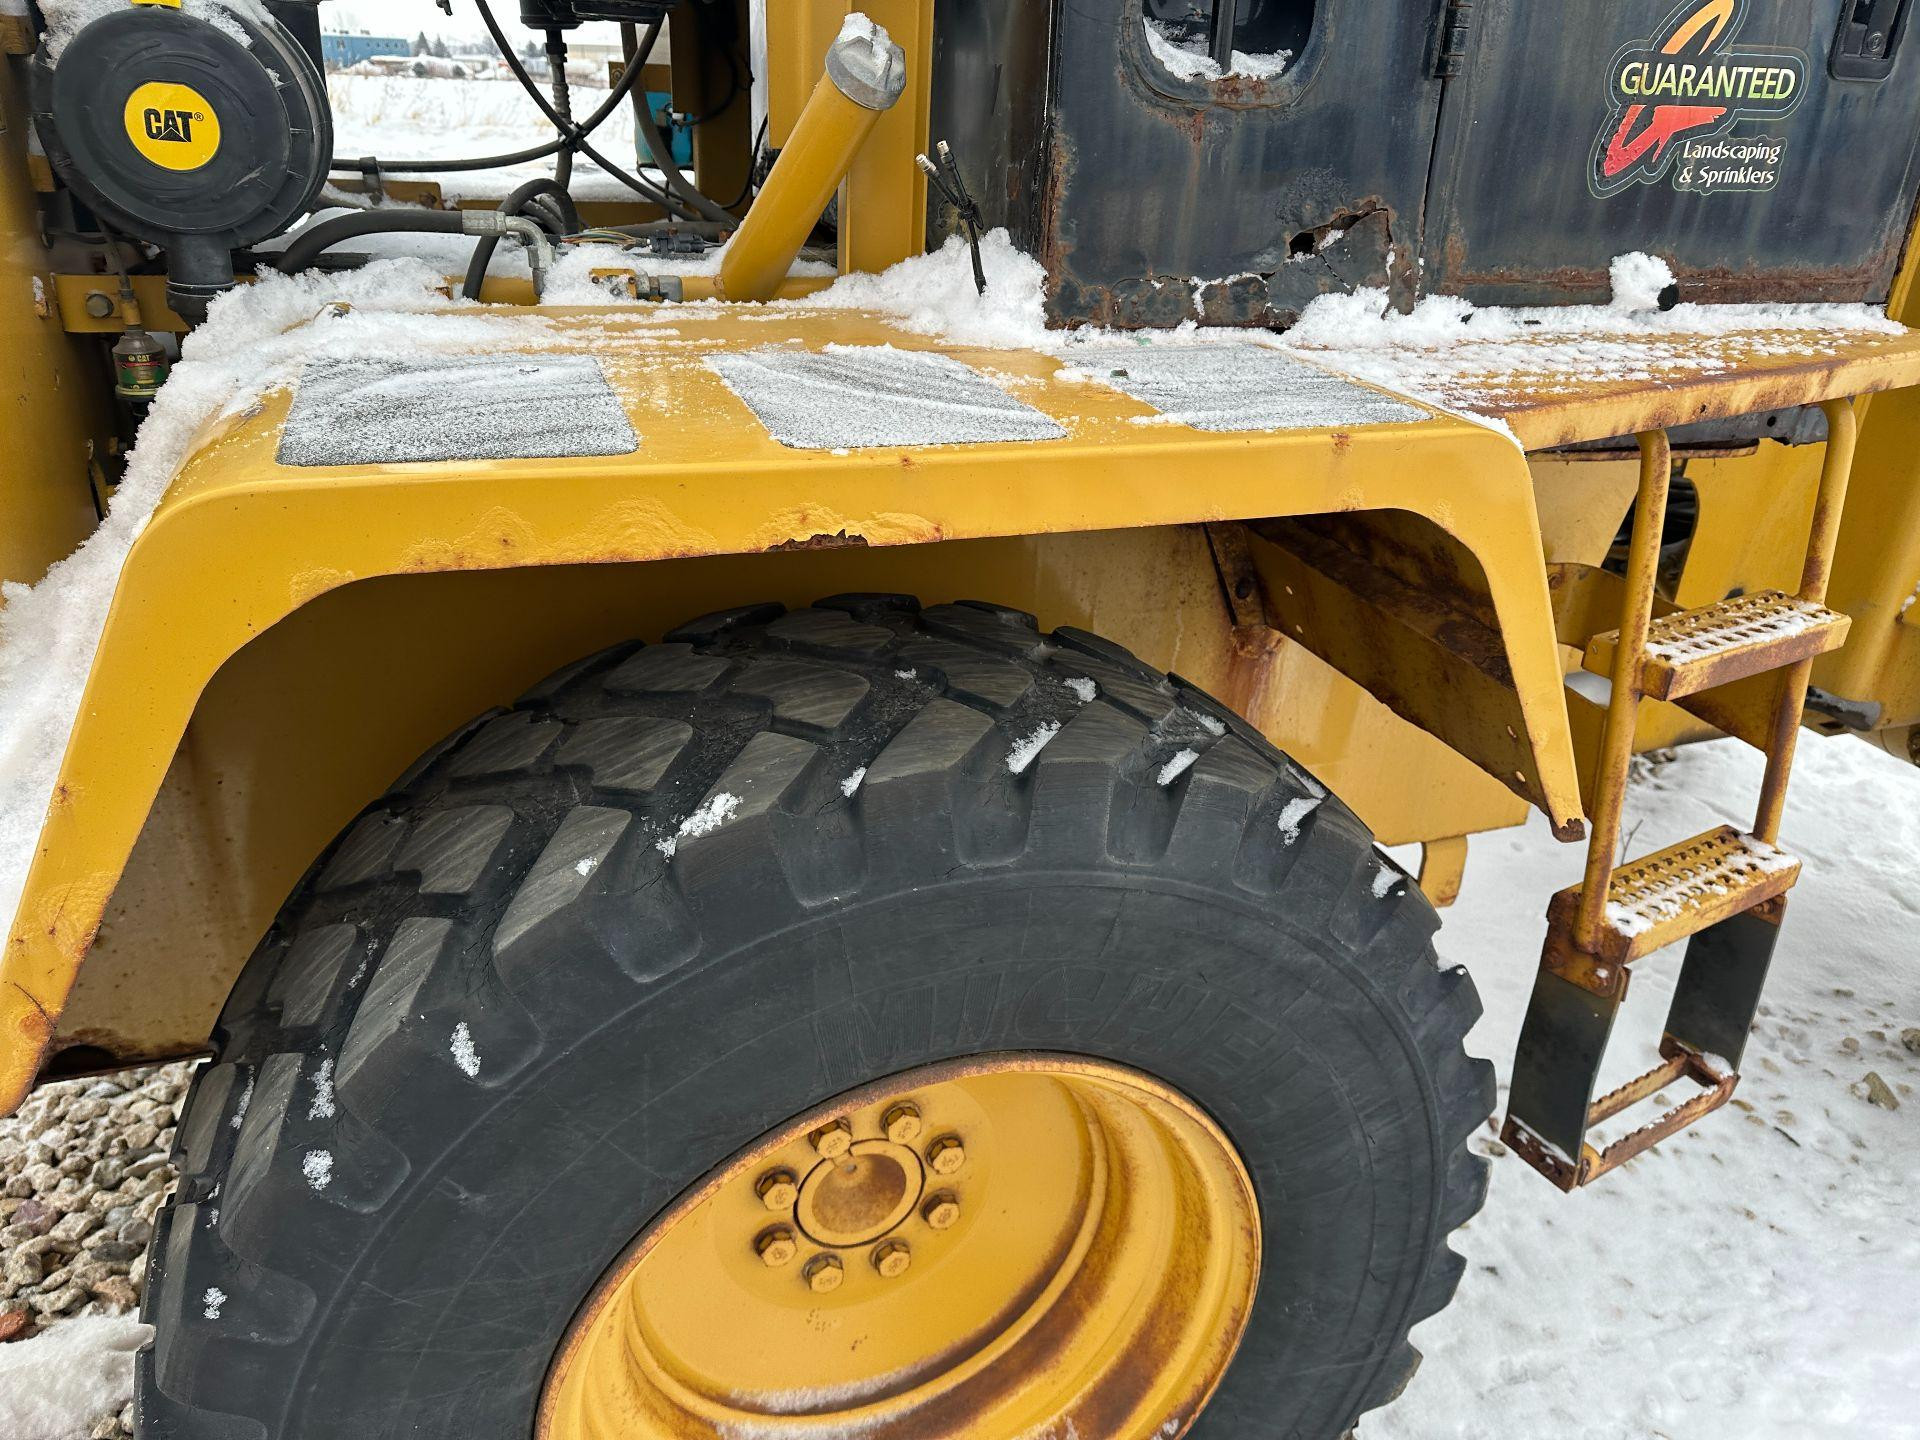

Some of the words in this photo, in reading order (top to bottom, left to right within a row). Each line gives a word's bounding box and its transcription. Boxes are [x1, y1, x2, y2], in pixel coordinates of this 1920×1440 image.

[1620, 62, 1795, 99] GUARANTEED
[1683, 140, 1781, 164] Landscaping
[1679, 165, 1692, 183] &
[1698, 166, 1774, 187] Sprinklers
